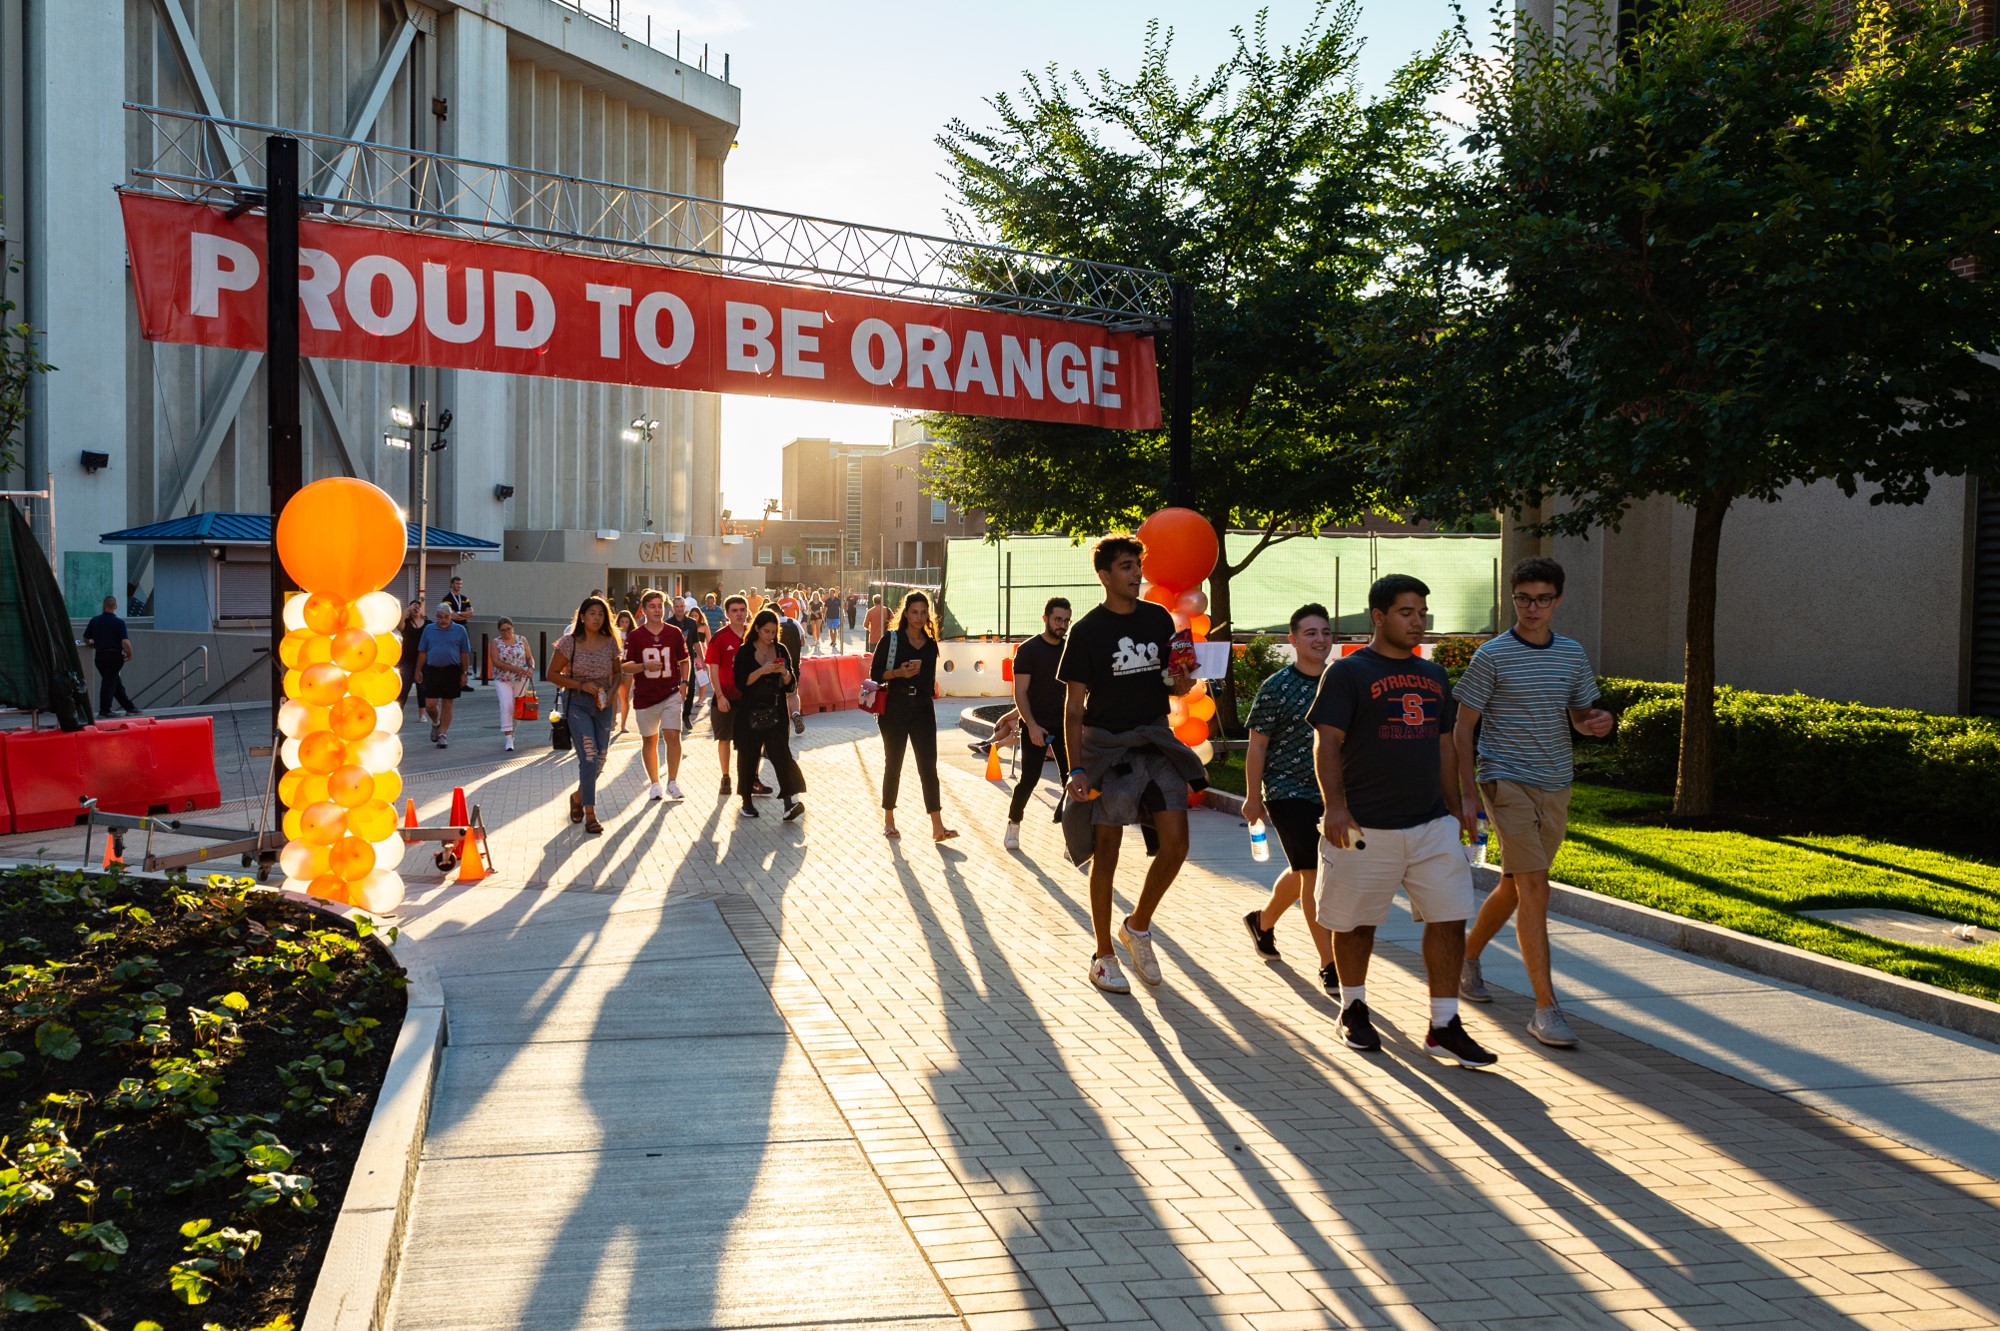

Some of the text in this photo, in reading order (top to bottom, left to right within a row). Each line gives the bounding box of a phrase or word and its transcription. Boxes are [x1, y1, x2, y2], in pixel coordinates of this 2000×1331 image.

[190, 231, 1122, 410] PROUD TO BE ORANGE
[639, 541, 695, 563] GATE N
[1402, 693, 1424, 726] S
[1378, 725, 1440, 740] ORANG
